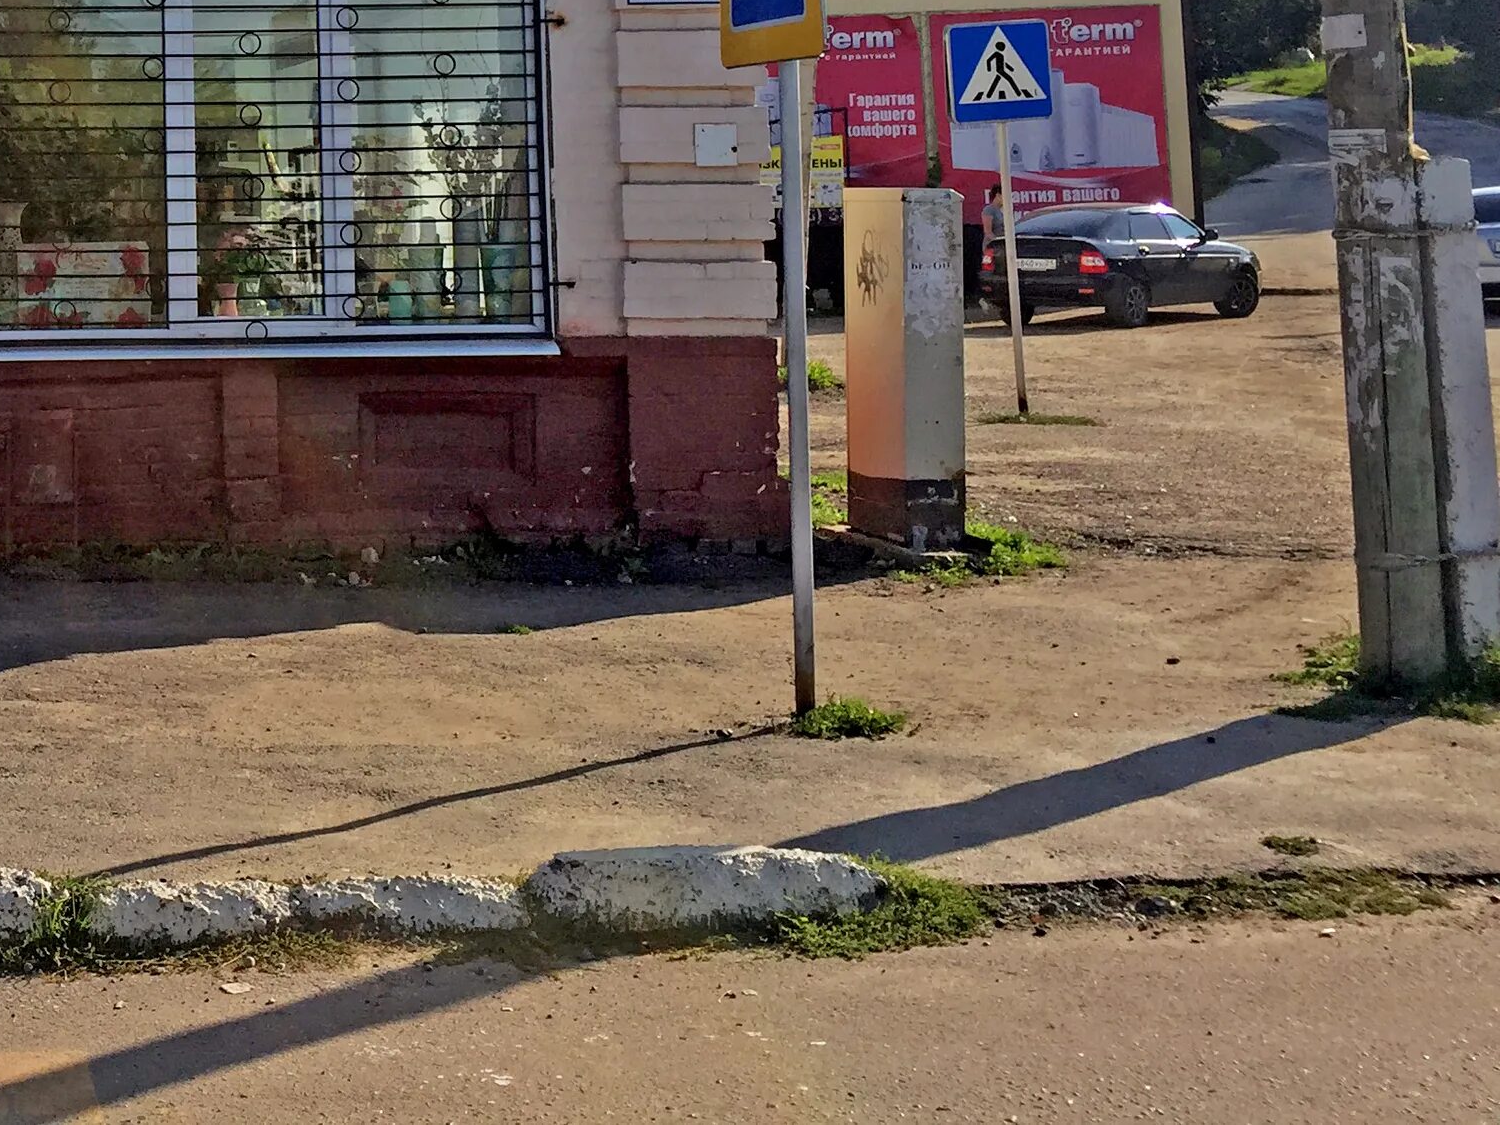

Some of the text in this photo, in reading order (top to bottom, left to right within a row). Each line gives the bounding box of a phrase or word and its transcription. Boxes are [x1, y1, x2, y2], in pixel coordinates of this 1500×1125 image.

[1051, 18, 1135, 44] term
[849, 93, 915, 108] Гарантия
[863, 109, 915, 122] вашего
[812, 159, 842, 168] ЕНЫ
[984, 187, 1120, 204] Гантия вашего
